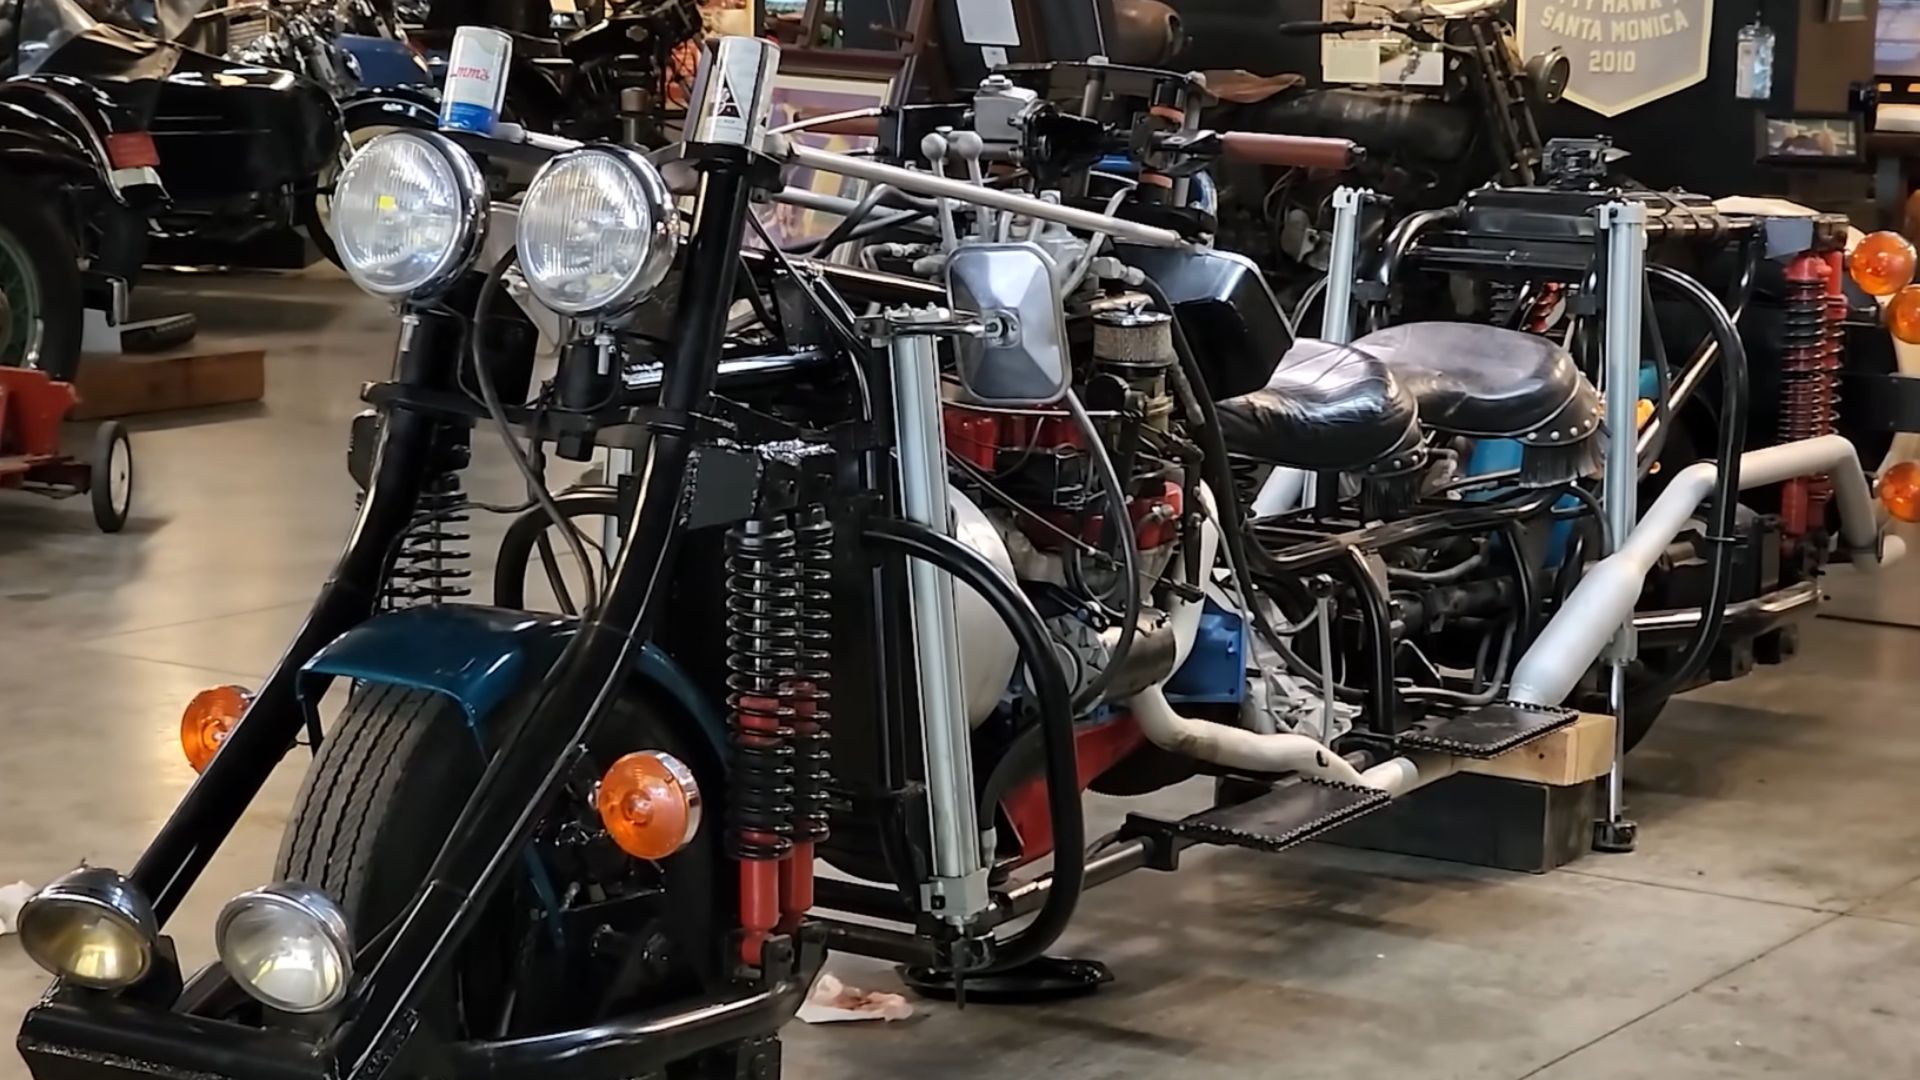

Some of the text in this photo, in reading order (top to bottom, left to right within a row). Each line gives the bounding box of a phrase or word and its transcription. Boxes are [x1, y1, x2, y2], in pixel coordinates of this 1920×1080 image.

[1540, 5, 1689, 43] SANTA MONICA
[1588, 50, 1636, 73] 2010
